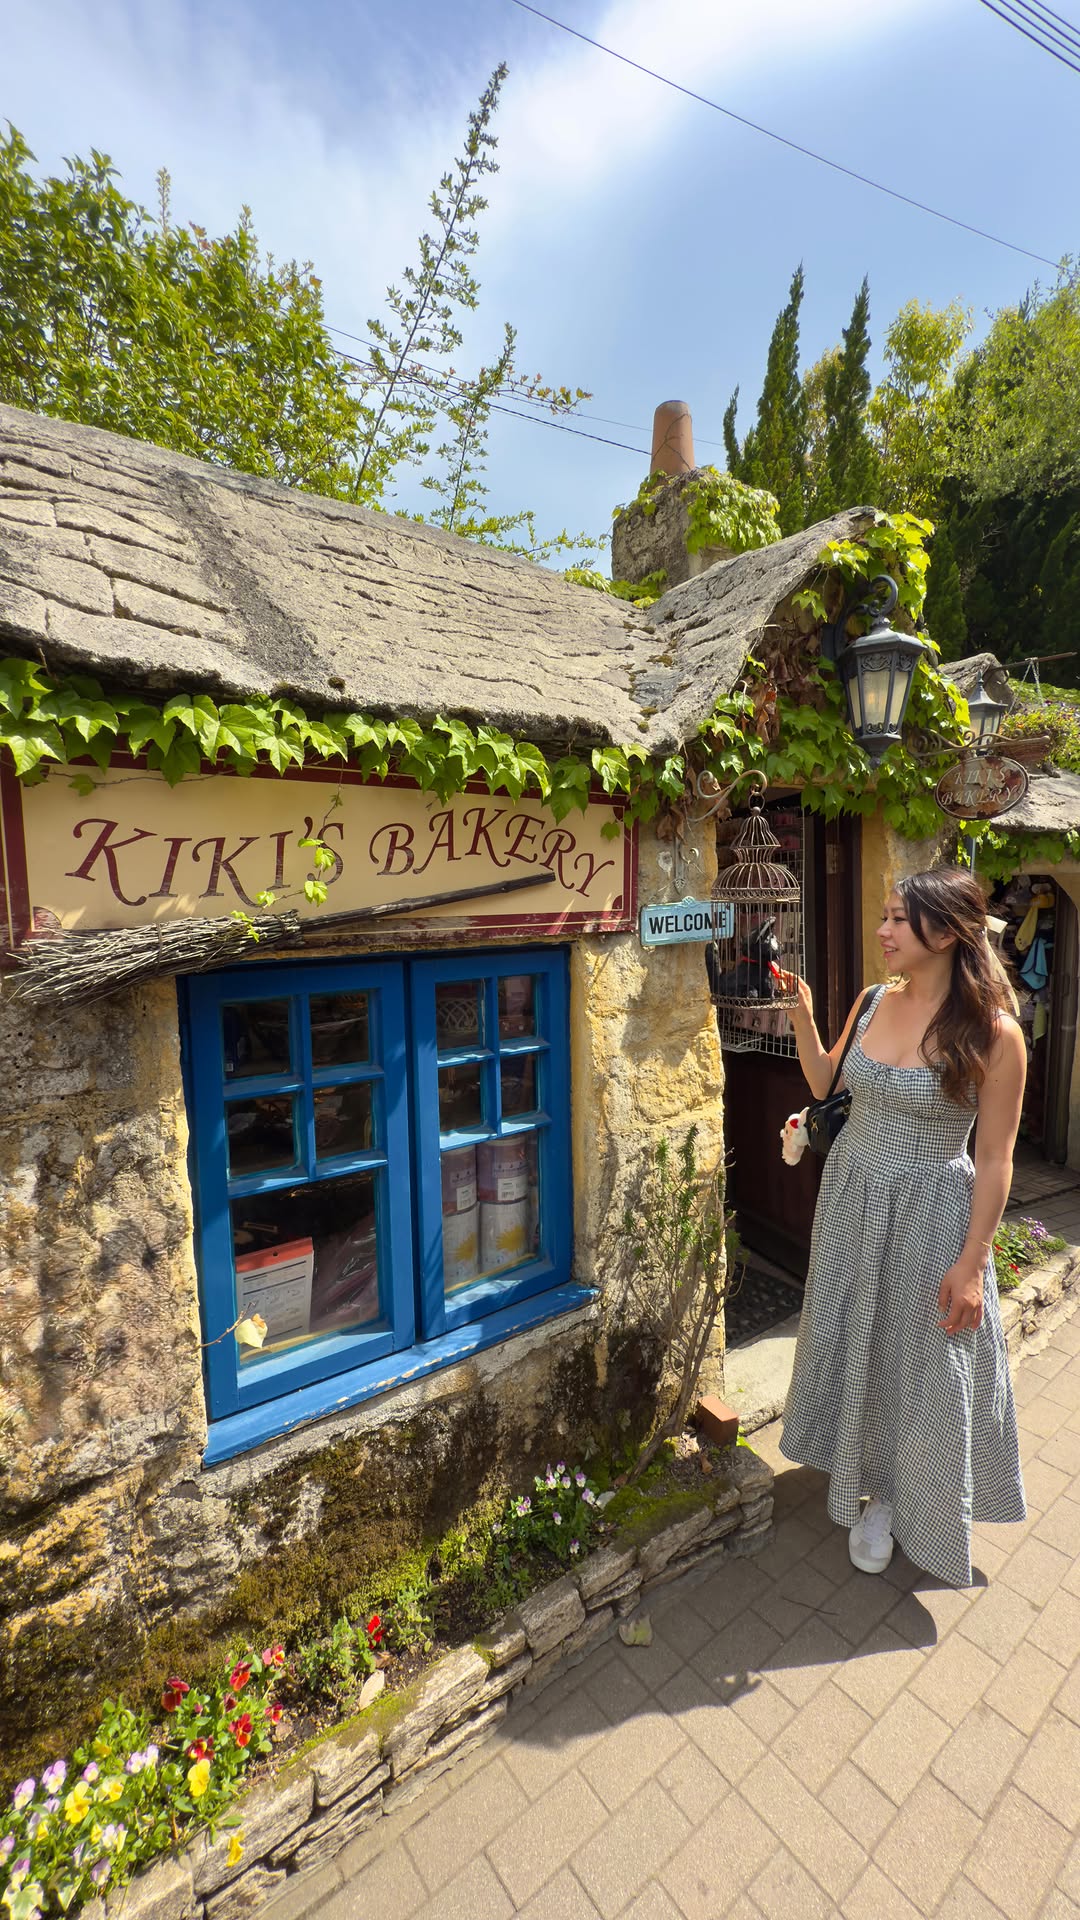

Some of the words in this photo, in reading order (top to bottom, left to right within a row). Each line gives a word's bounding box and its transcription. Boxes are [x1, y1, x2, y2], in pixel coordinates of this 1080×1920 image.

[65, 816, 344, 907] KIKI'S
[369, 807, 615, 897] BAKERY
[649, 912, 727, 935] WELCOME
